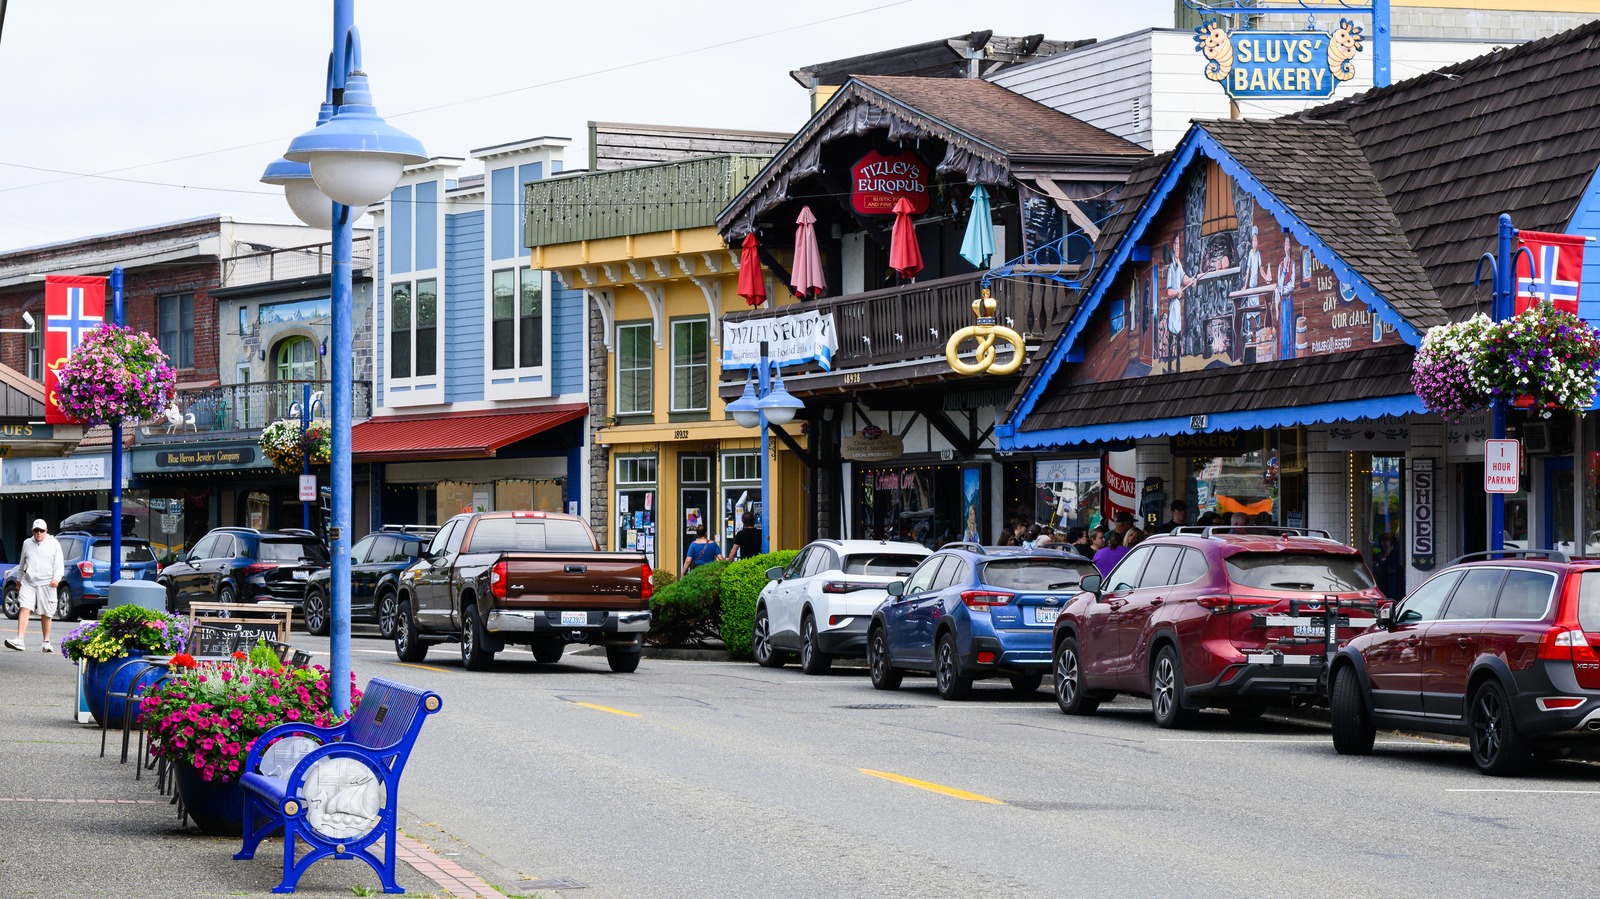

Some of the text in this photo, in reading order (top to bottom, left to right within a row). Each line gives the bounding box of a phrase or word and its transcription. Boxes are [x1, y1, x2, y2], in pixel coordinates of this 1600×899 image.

[1237, 39, 1322, 63] SLUYS'
[1234, 67, 1326, 91] BAKERY
[860, 161, 920, 179] TIZLEY'S
[1331, 312, 1348, 329] OUR
[674, 430, 689, 439] 18932
[1176, 435, 1239, 447] BAKERY
[180, 453, 195, 463] Heron
[217, 451, 240, 462] Company
[1500, 447, 1504, 457] 1
[37, 463, 56, 478] bath
[74, 461, 99, 476] books
[1492, 462, 1511, 471] HOUR
[1488, 475, 1516, 485] PARKING
[1415, 472, 1431, 553] SHOES
